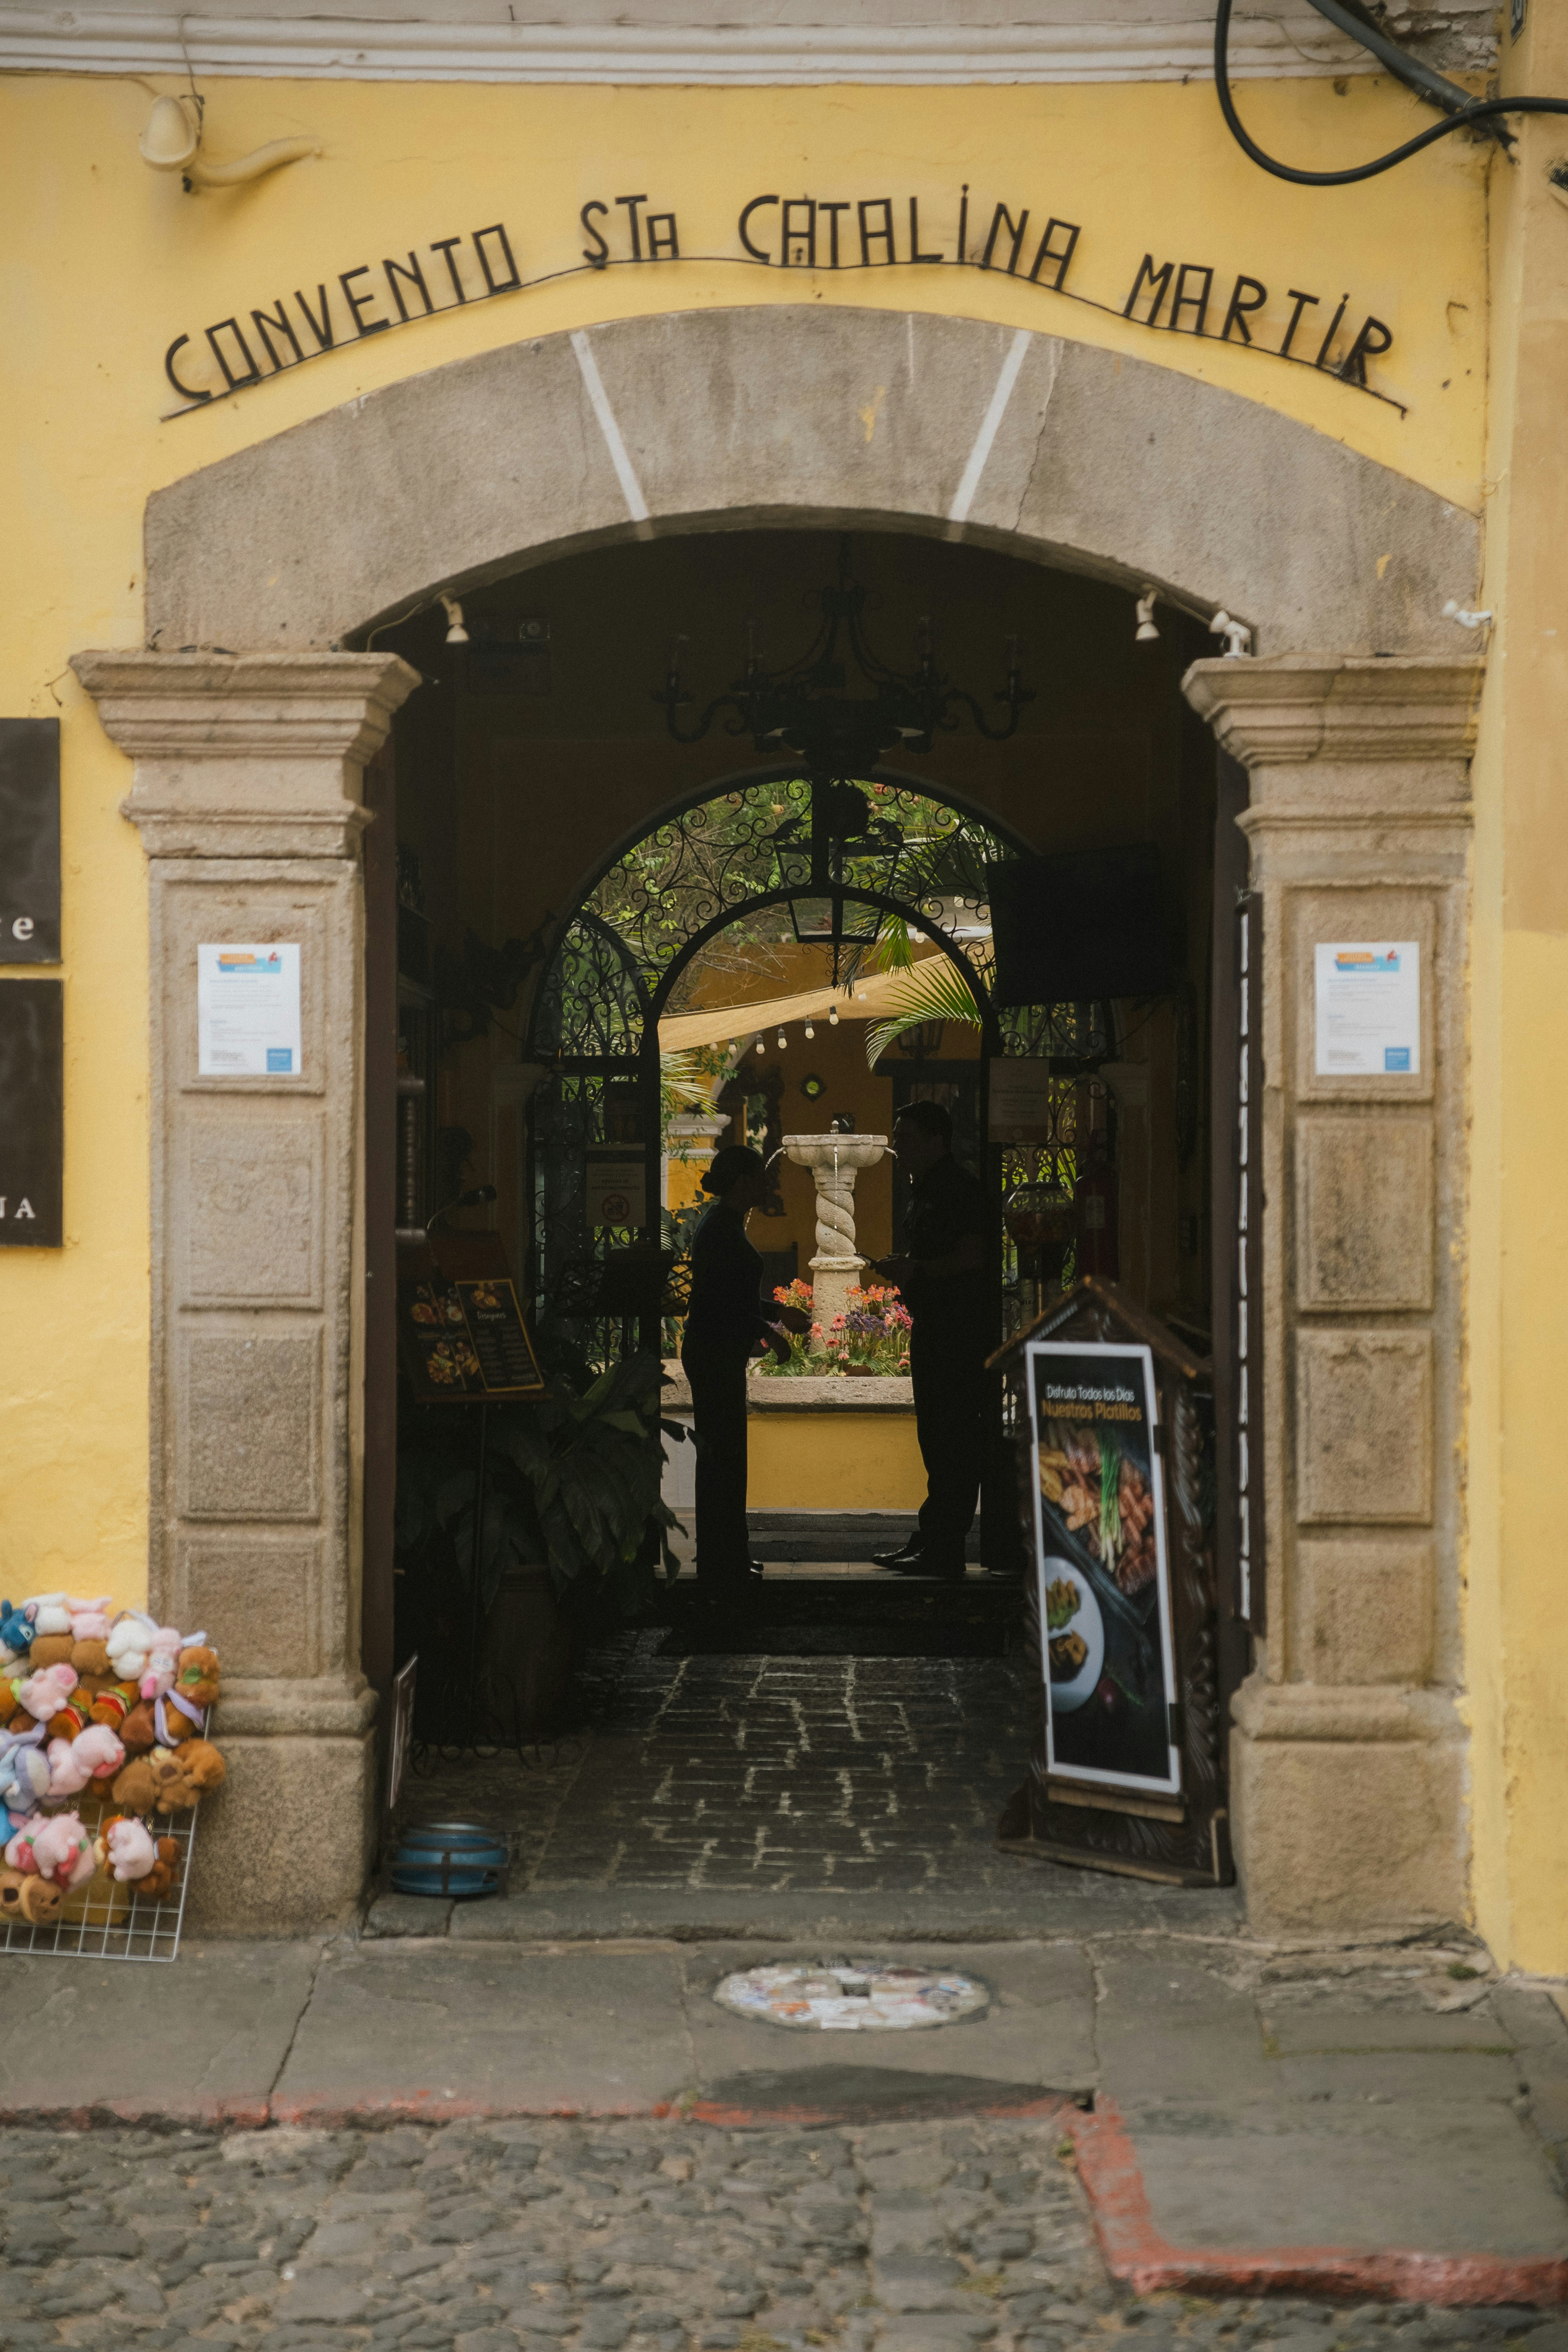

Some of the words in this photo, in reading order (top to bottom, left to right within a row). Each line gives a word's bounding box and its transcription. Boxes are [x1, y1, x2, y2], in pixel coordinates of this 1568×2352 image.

[165, 224, 521, 400] CONVENTO
[738, 183, 1082, 292] CATALINA
[1047, 1384, 1077, 1399] Disfruta
[1077, 1386, 1103, 1400] Todos
[1103, 1387, 1115, 1401] los
[1042, 1400, 1093, 1419] Nuestros
[1094, 1401, 1142, 1421] Platillos
